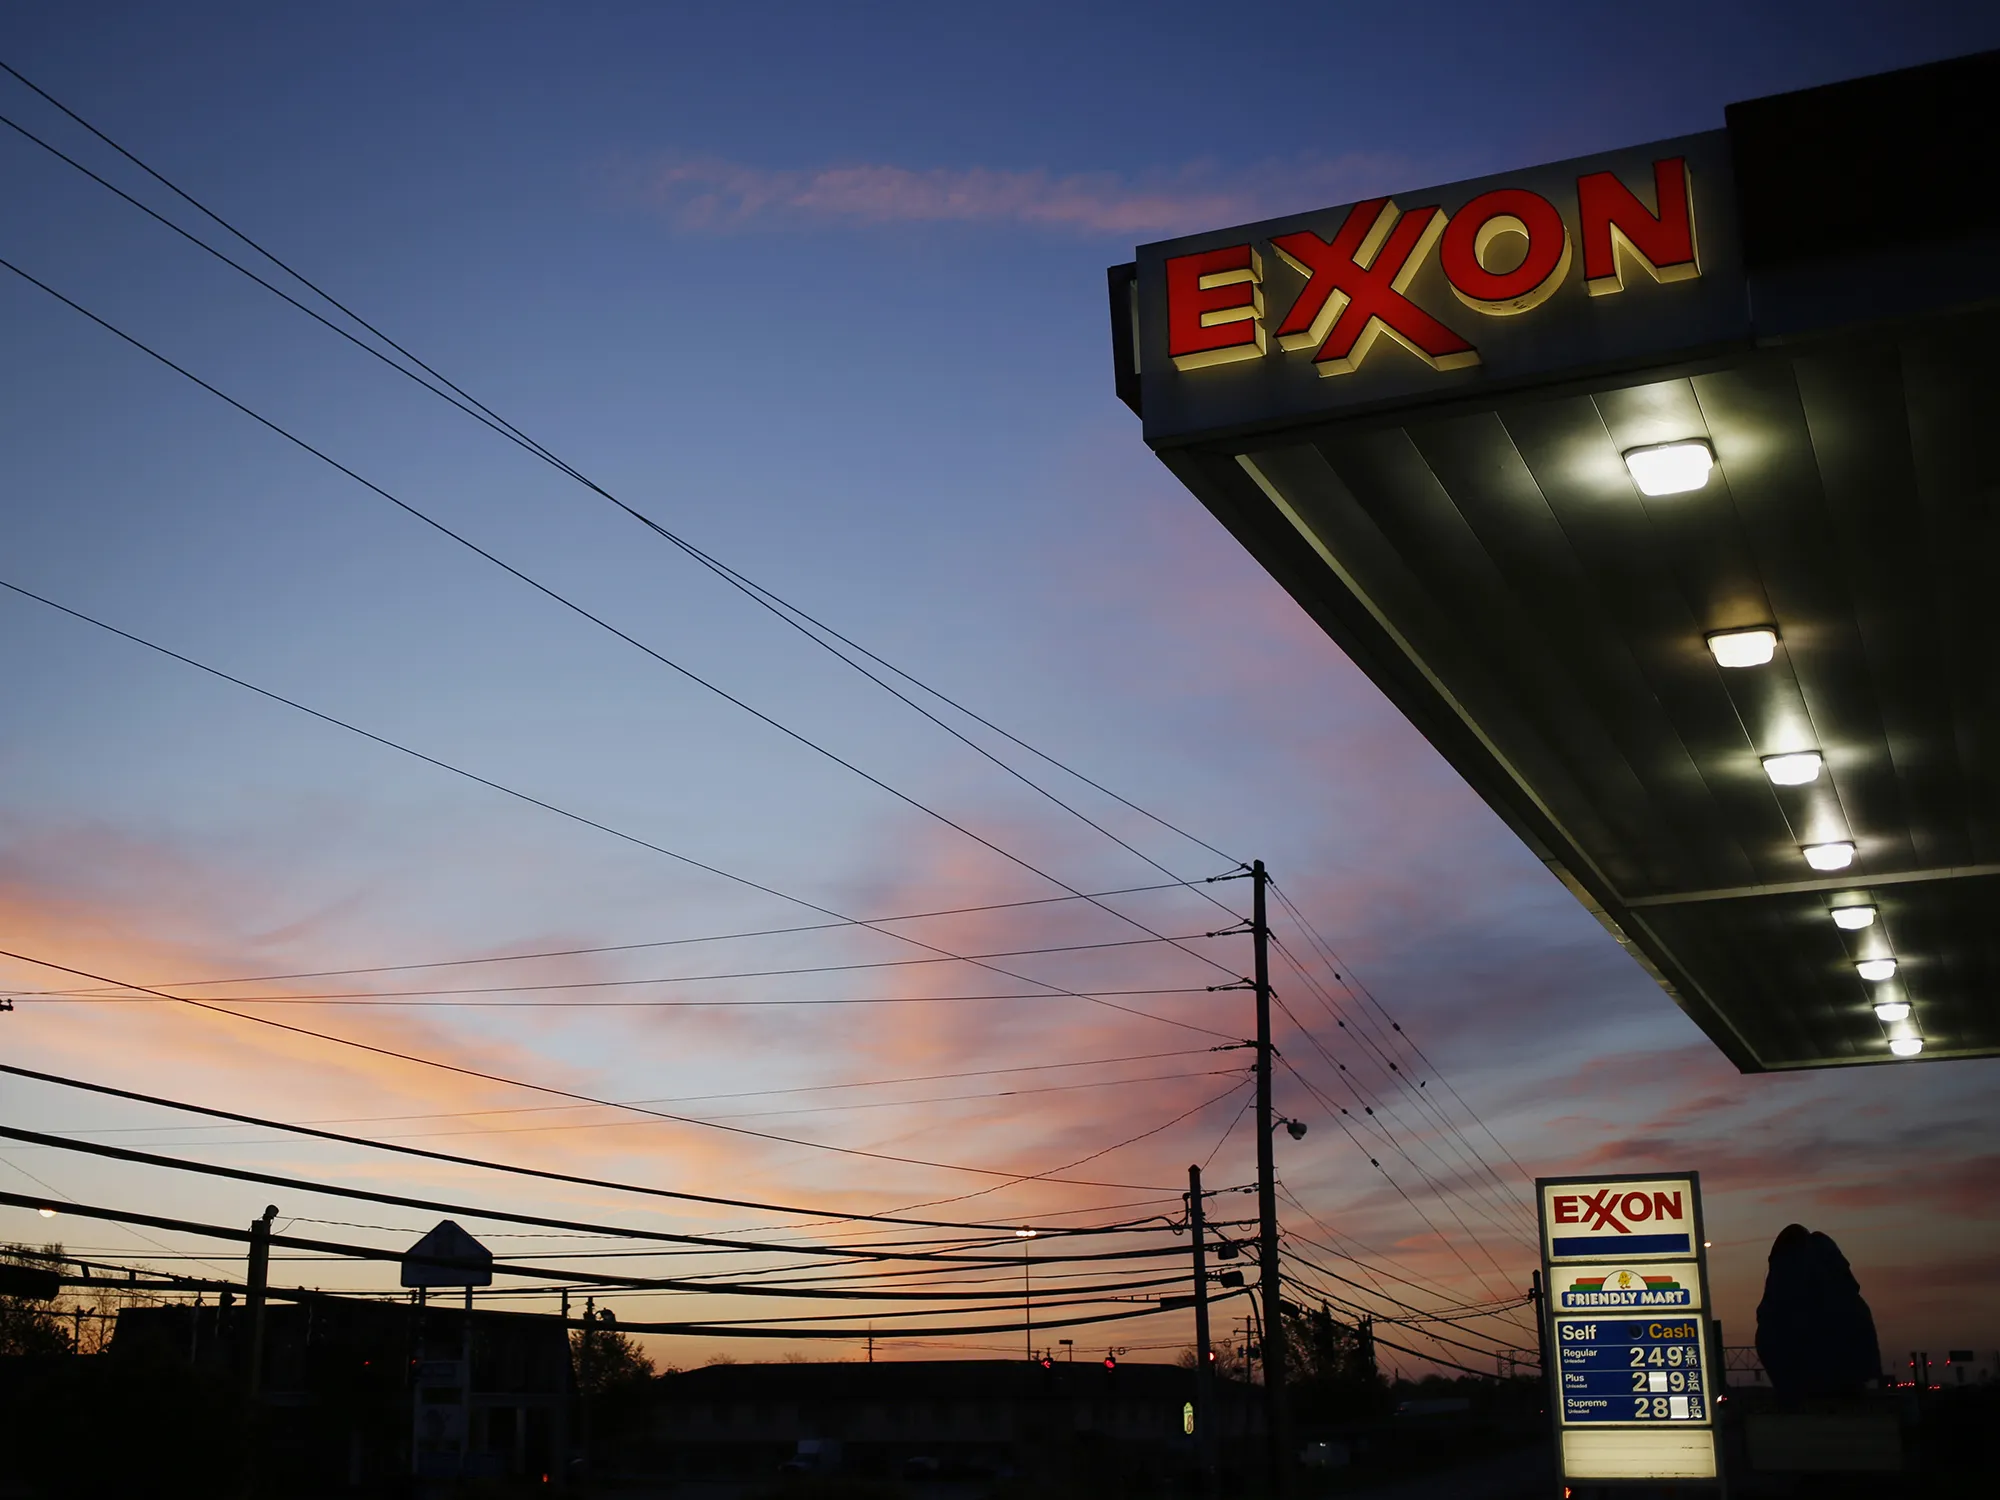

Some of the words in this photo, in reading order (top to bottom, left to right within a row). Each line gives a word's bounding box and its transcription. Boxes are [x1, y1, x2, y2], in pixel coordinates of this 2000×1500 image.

[1164, 156, 1701, 377] EXXON
[1553, 1189, 1683, 1234] EXXON
[1566, 1291, 1638, 1306] FRIENDLY
[1640, 1290, 1685, 1305] MART
[1562, 1324, 1597, 1340] Self
[1649, 1323, 1695, 1338] Cash
[1563, 1349, 1597, 1358] Regular
[1630, 1347, 1683, 1367] 249
[1565, 1374, 1584, 1382] Plus
[1567, 1399, 1608, 1408] Supreme
